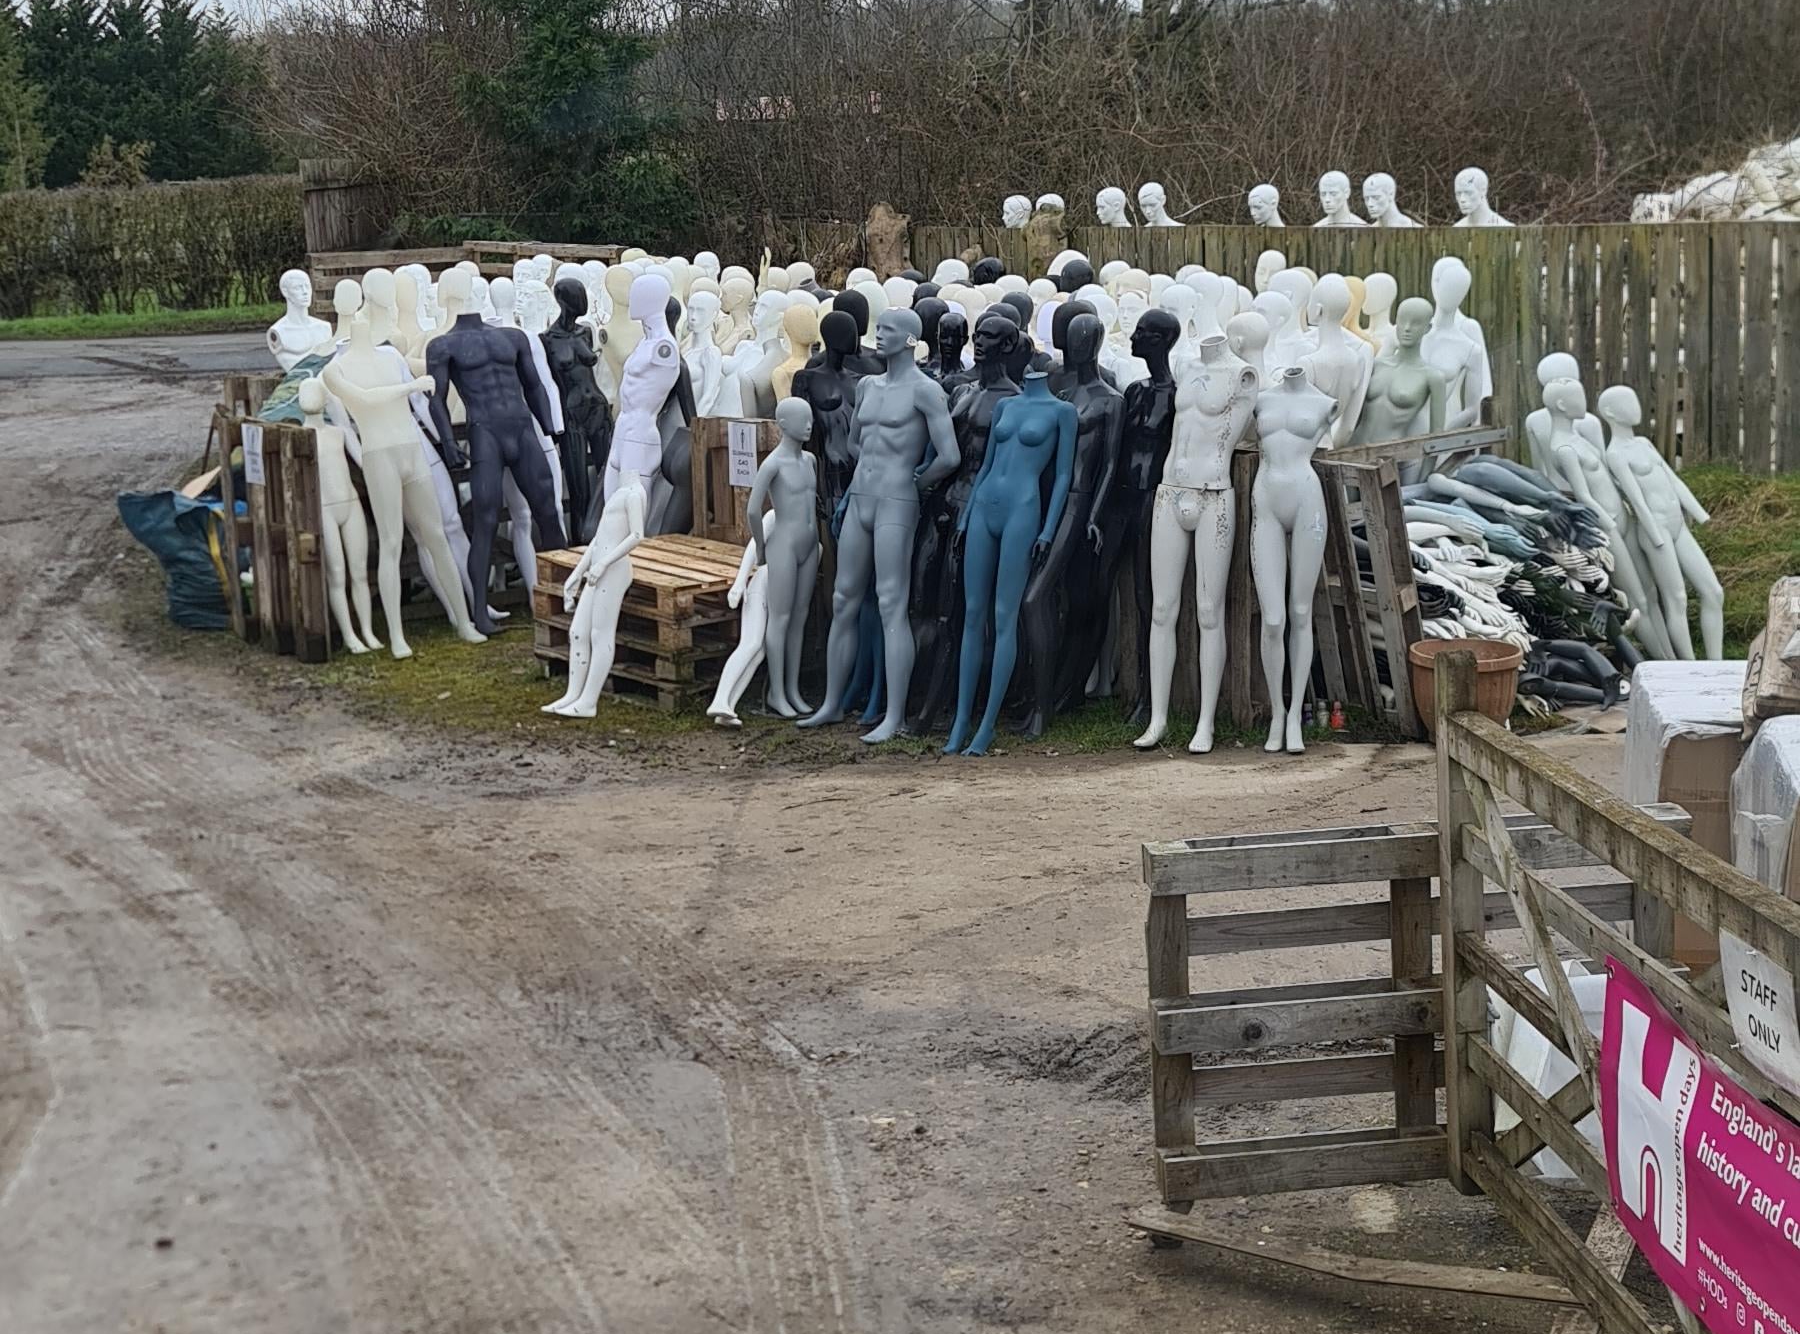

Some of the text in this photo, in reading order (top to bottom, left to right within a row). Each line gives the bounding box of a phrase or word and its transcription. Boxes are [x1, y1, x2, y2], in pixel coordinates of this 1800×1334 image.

[1741, 969, 1777, 1011] STAFF
[1748, 1013, 1780, 1053] ONLY
[1710, 1081, 1785, 1164] England's
[1673, 1057, 1696, 1253] heritage open days
[1697, 1131, 1751, 1205] history
[1751, 1187, 1785, 1228] and
[1698, 1267, 1728, 1309] #HODs
